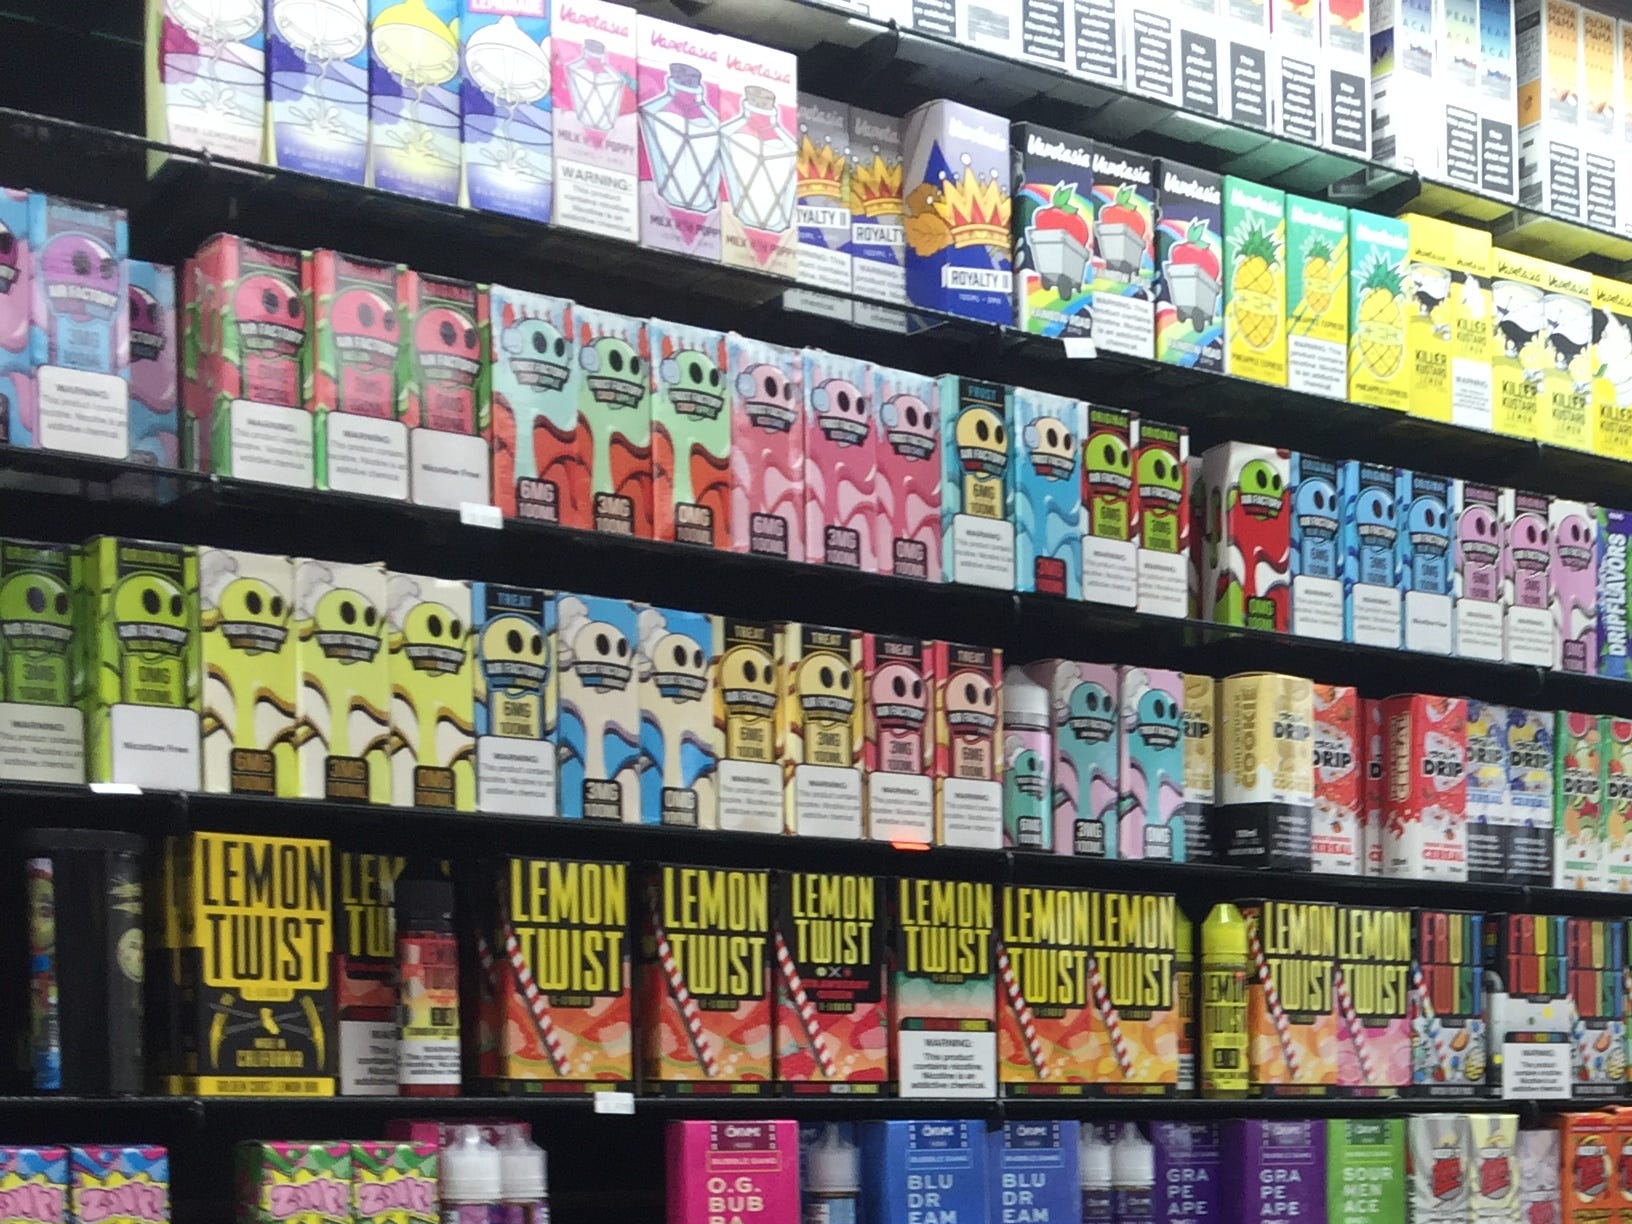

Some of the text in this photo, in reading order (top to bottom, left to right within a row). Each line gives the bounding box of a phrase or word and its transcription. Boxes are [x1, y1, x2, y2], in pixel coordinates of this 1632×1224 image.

[561, 165, 632, 191] WARNING:
[951, 270, 999, 288] ROYALTY
[1609, 533, 1627, 657] DRIPFLAVORS
[1273, 721, 1311, 741] DRIP
[1423, 757, 1464, 777] DRIP
[1510, 751, 1549, 768] DRIP
[1563, 778, 1599, 795] DRIP
[202, 839, 327, 910] LEMON
[511, 858, 626, 926] LEMON
[663, 867, 769, 932] LEMON
[793, 873, 874, 921] LEMON
[901, 879, 993, 928] LEMON
[1004, 887, 1089, 946] LEMON
[1091, 892, 1175, 950] LEMON
[1265, 902, 1335, 957] LEMON
[1338, 908, 1411, 961] LEMON
[206, 913, 325, 981] TWIST
[795, 919, 873, 965] TWIST
[902, 926, 992, 975] TWIST
[515, 928, 624, 993] TWIST
[667, 933, 767, 997] TWIST
[1006, 948, 1088, 1005] TWIST
[1094, 952, 1173, 1008] TWIST
[1267, 960, 1334, 1011] TWIST
[1340, 964, 1409, 1015] TWIST
[707, 1177, 762, 1194] O.G.
[907, 1174, 953, 1190] BLU
[1002, 1173, 1046, 1188] BLU
[1166, 1168, 1209, 1183] GRA
[1259, 1169, 1301, 1184] GRA
[1342, 1167, 1394, 1182] SOUR
[907, 1193, 941, 1208] DR
[1002, 1191, 1034, 1206] DR
[1167, 1185, 1195, 1199] PE
[1260, 1186, 1287, 1200] PE
[708, 1196, 764, 1213] BUB
[1002, 1208, 1049, 1224] EAM
[1166, 1201, 1208, 1215] APE
[1260, 1202, 1300, 1216] APE
[1343, 1200, 1380, 1214] ACE
